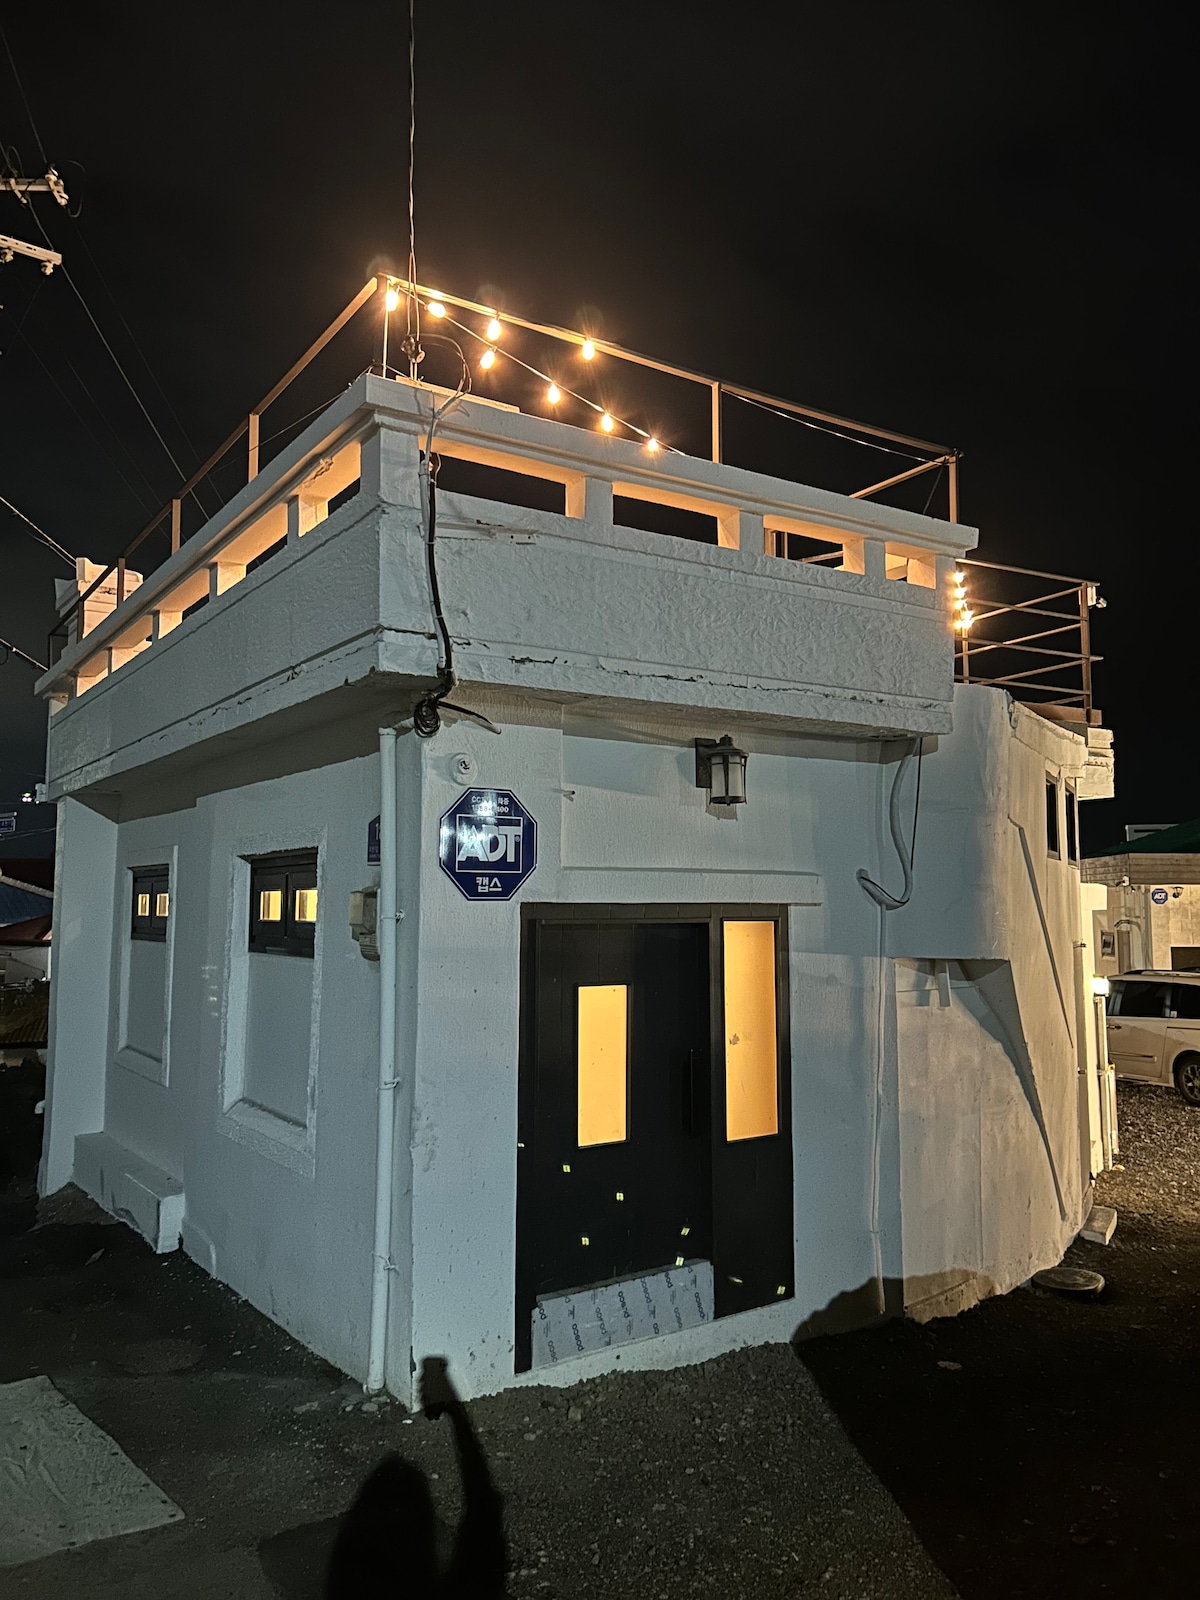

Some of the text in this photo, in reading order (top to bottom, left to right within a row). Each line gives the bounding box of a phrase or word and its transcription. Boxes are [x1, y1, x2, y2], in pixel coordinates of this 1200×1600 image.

[457, 824, 522, 862] ADT
[475, 876, 502, 893] 캡스
[572, 1323, 584, 1352] posco
